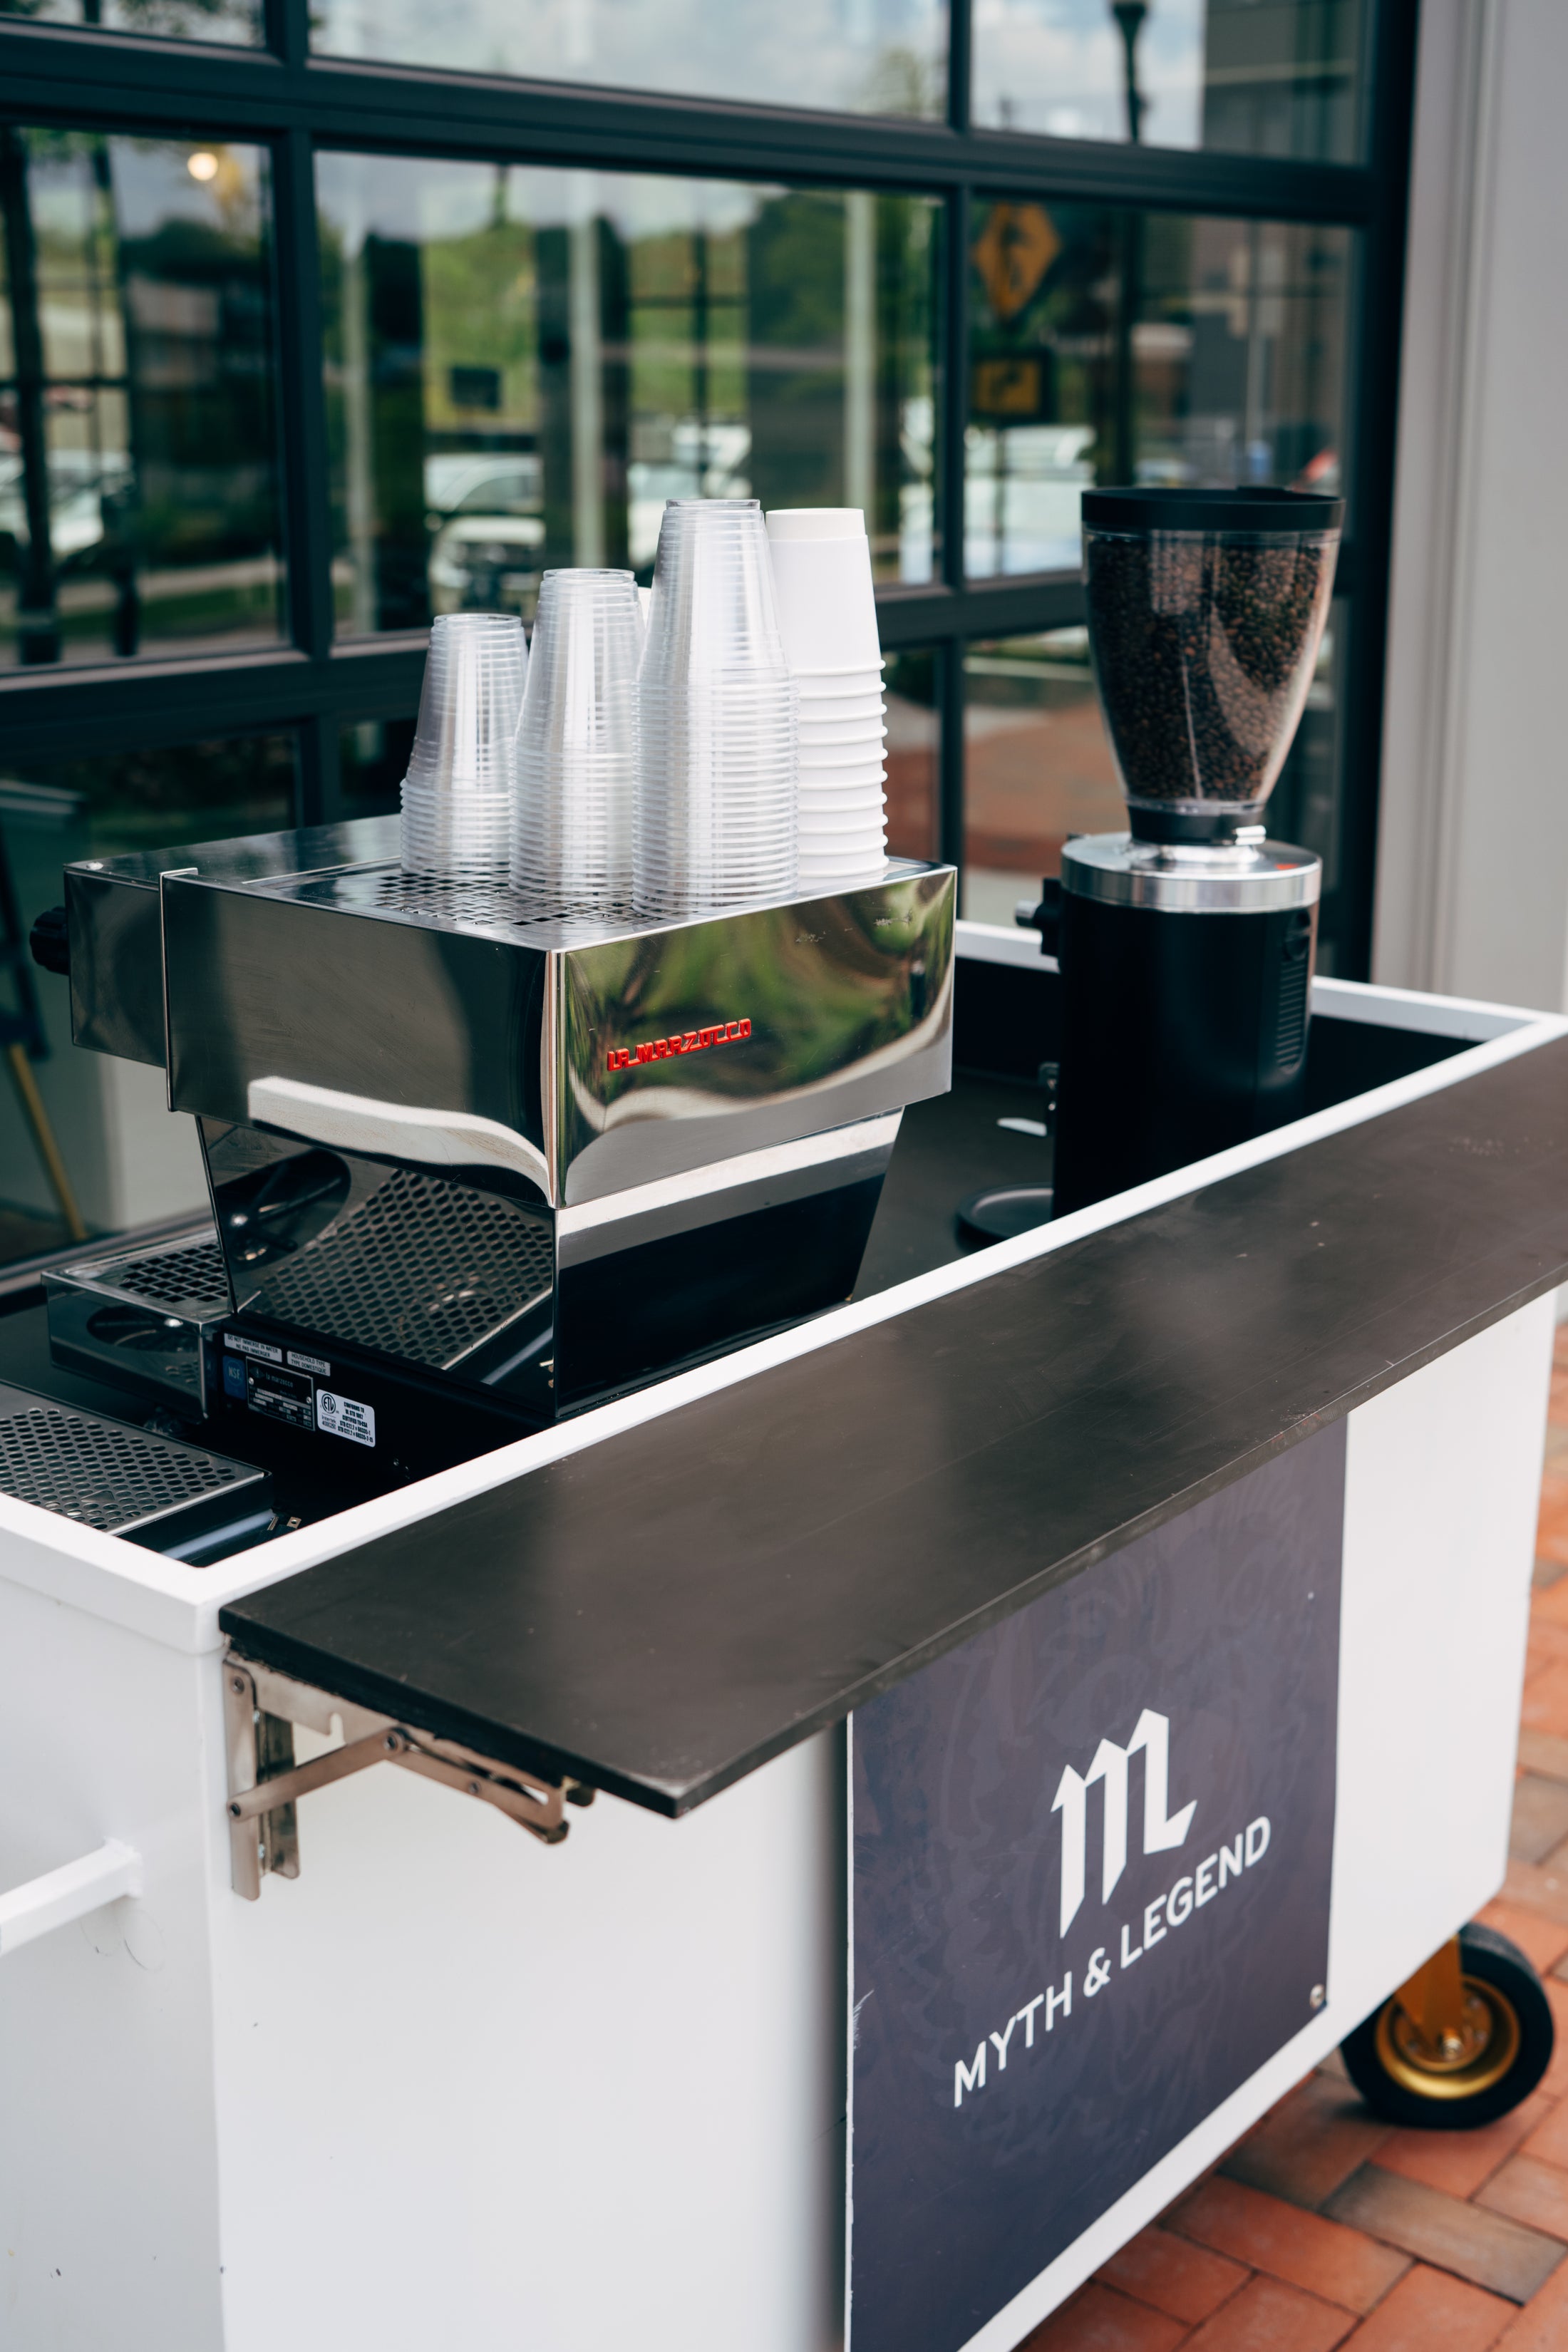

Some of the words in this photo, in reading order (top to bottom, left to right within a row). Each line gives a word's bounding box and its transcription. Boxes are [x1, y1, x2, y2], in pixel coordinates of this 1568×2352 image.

[607, 1048, 630, 1071] LA
[635, 1018, 751, 1063] MARZOCCO
[242, 1338, 259, 1348] IMMERSE
[265, 1344, 278, 1353] WATER
[250, 1347, 270, 1357] IMMERGER
[292, 1353, 315, 1364] HOUSEHOLD
[228, 1366, 240, 1380] NSF
[301, 1362, 326, 1374] DOMESTIQUE
[271, 1375, 294, 1388] marzocco
[344, 1401, 360, 1412] CONFORMS
[321, 1415, 336, 1424] Intertek
[342, 1415, 356, 1424] CERTIFIED
[954, 1971, 1073, 2108] MYTH
[1083, 1947, 1111, 1997] &
[1120, 1816, 1271, 1969] LEGEND
